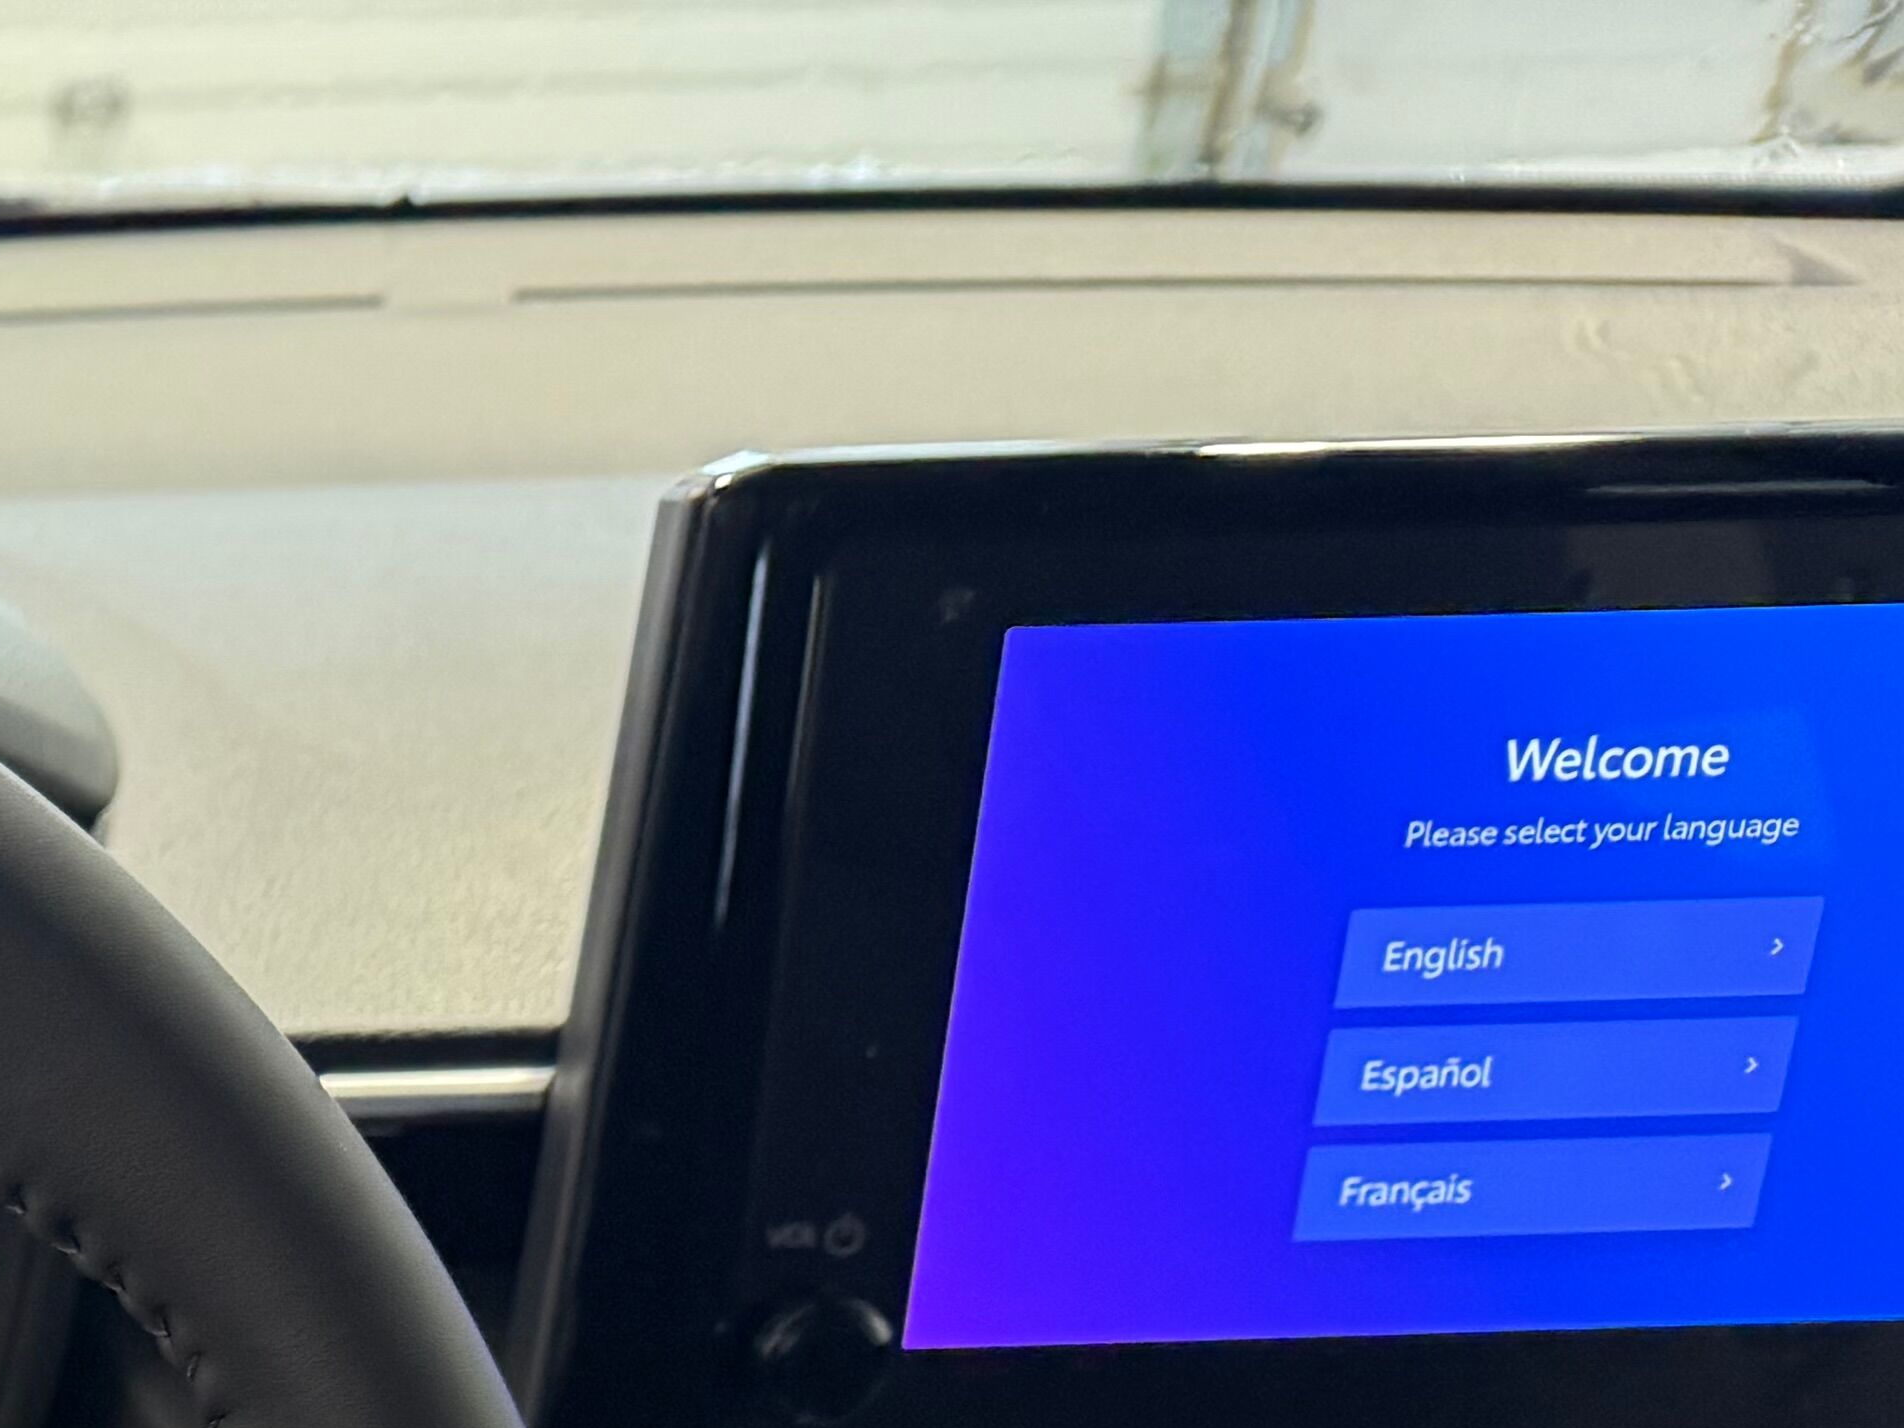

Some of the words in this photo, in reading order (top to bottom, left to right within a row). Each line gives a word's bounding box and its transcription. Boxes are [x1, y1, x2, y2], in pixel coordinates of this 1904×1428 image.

[1508, 735, 1729, 782] Welcome
[1405, 820, 1498, 848] Please
[1502, 817, 1586, 846] select
[1589, 820, 1657, 850] your
[1663, 813, 1800, 847] language
[1383, 938, 1505, 980] English
[1360, 1056, 1494, 1097] Español
[1339, 1173, 1473, 1212] Français
